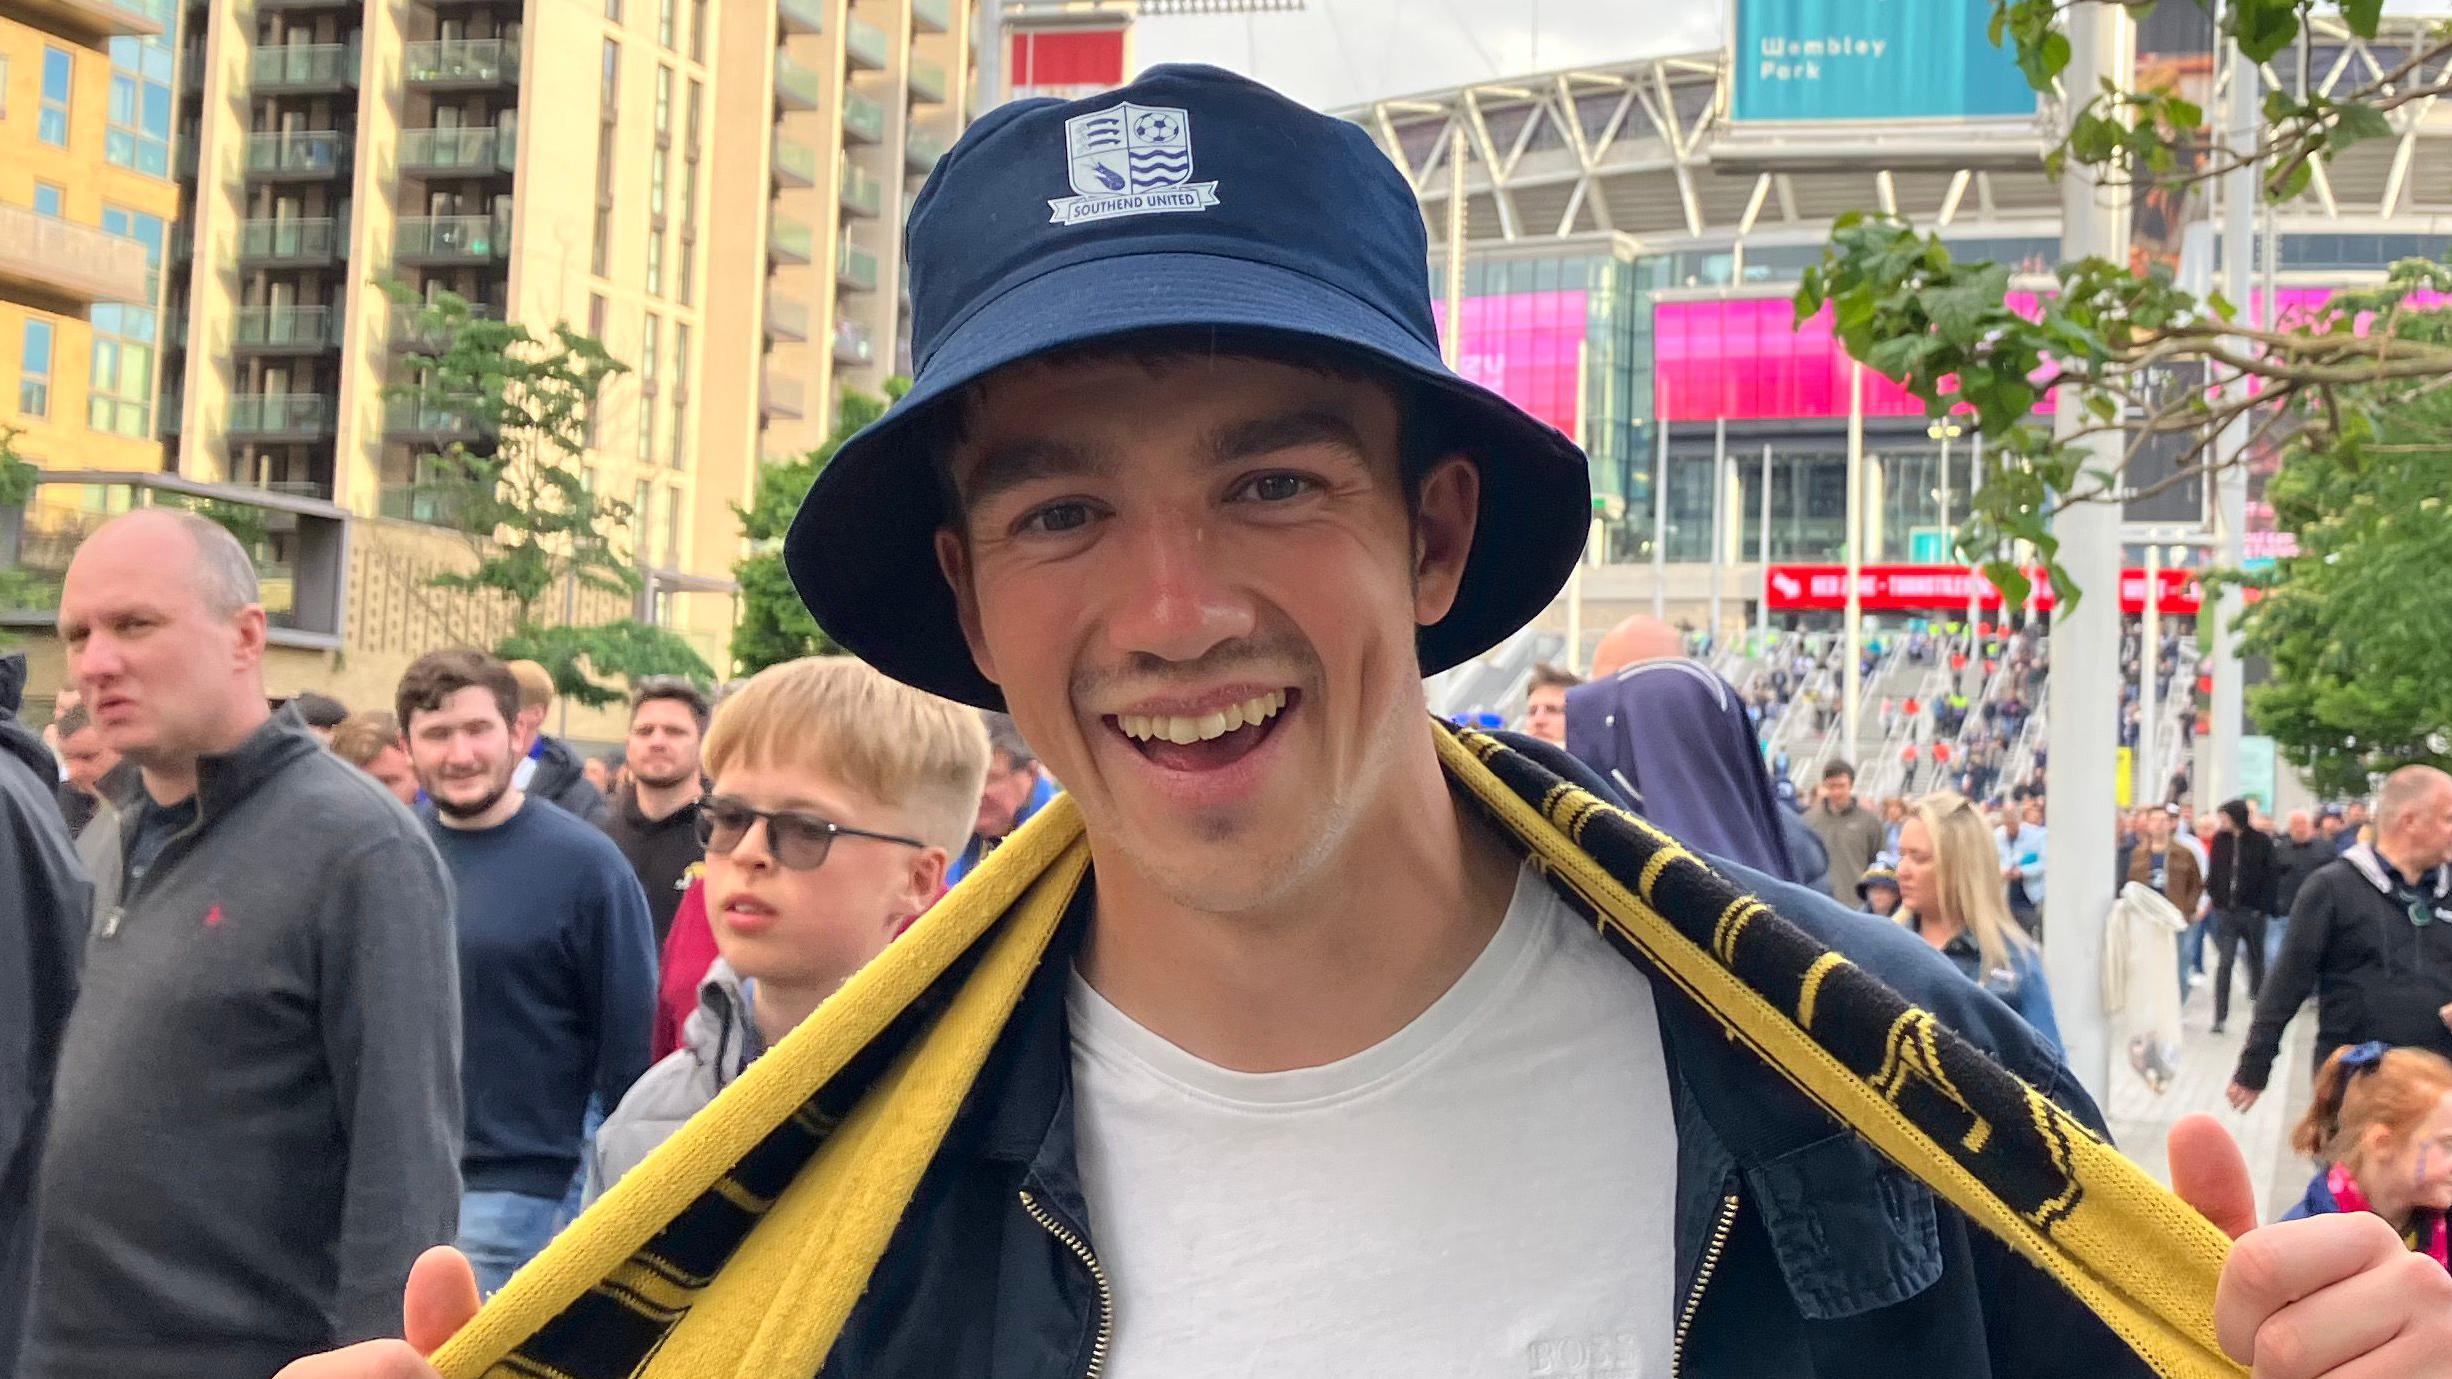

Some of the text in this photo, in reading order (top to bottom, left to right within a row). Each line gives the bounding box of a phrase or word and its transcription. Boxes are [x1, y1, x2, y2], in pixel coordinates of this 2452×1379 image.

[1761, 36, 1886, 58] Wembley
[1760, 61, 1820, 80] Park
[1074, 193, 1195, 218] SOUTHEND UNITED
